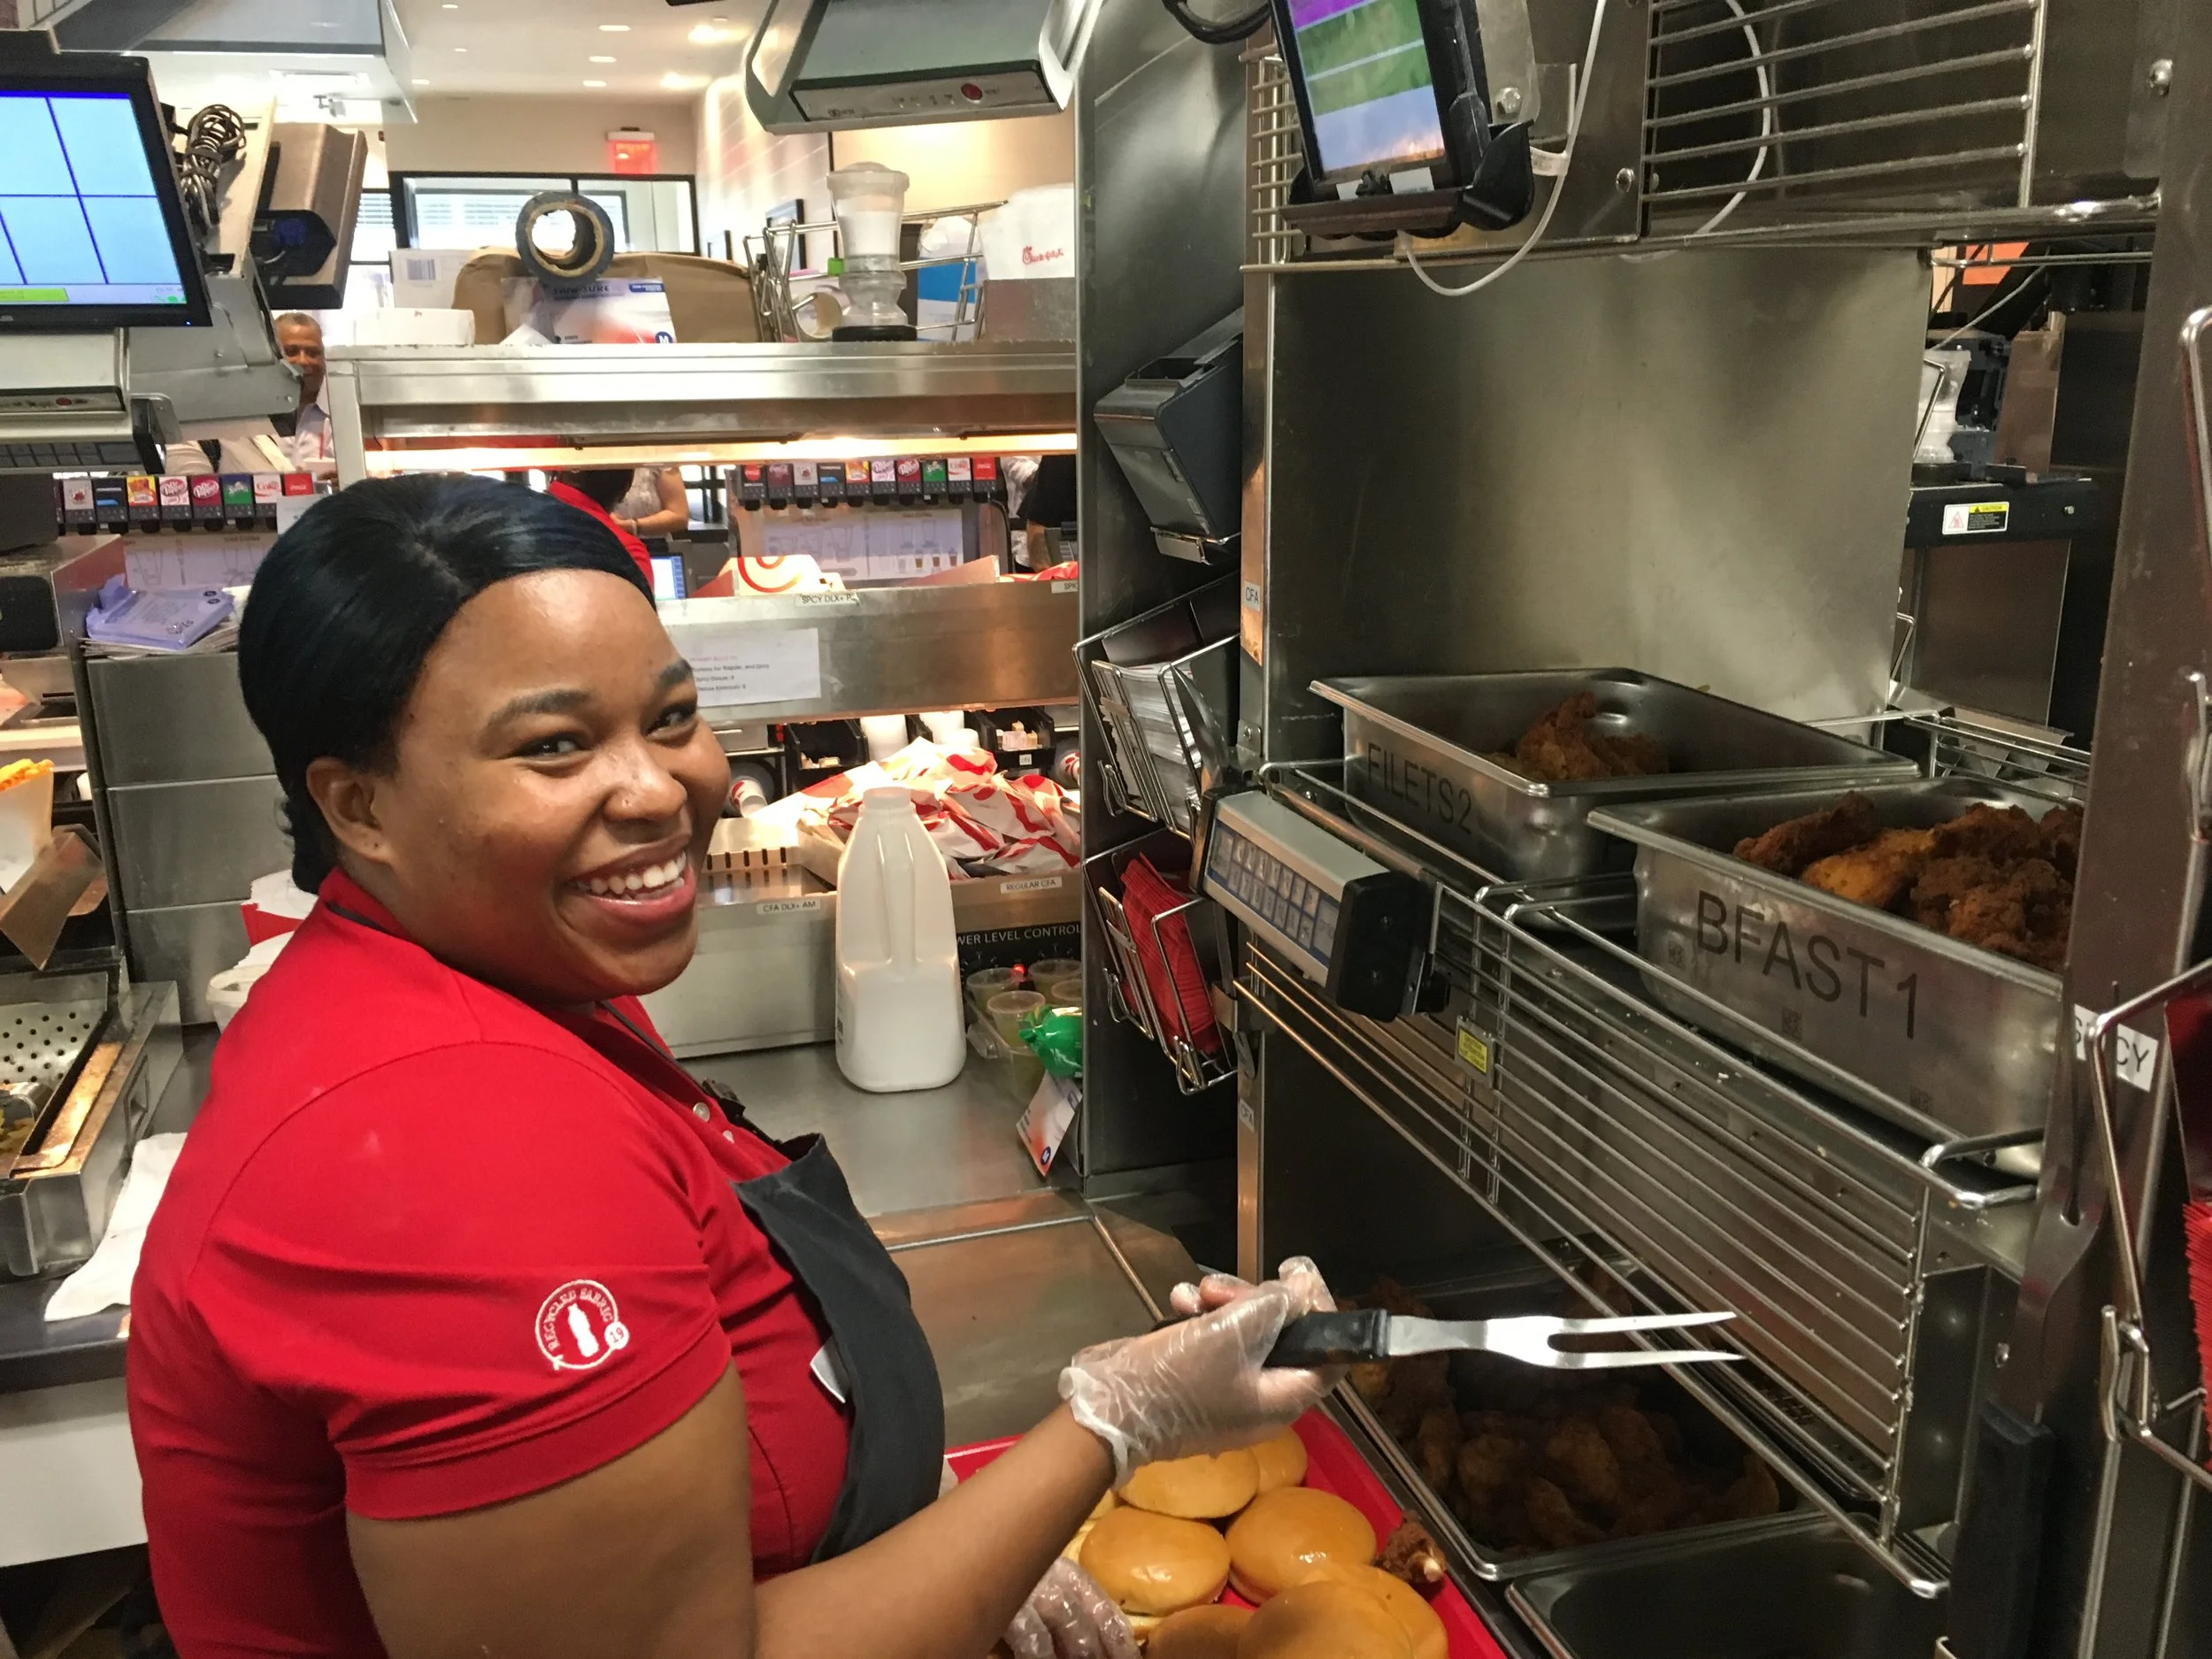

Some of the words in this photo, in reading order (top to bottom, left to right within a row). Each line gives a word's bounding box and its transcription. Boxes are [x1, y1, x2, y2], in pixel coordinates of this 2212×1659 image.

[1245, 586, 1259, 604] CFA
[1006, 880, 1040, 891] REGULAR
[1041, 879, 1056, 887] CFA
[763, 903, 780, 913] CFA
[957, 933, 981, 946] WER
[984, 929, 1021, 944] LEVEL
[609, 1327, 625, 1343] 19
